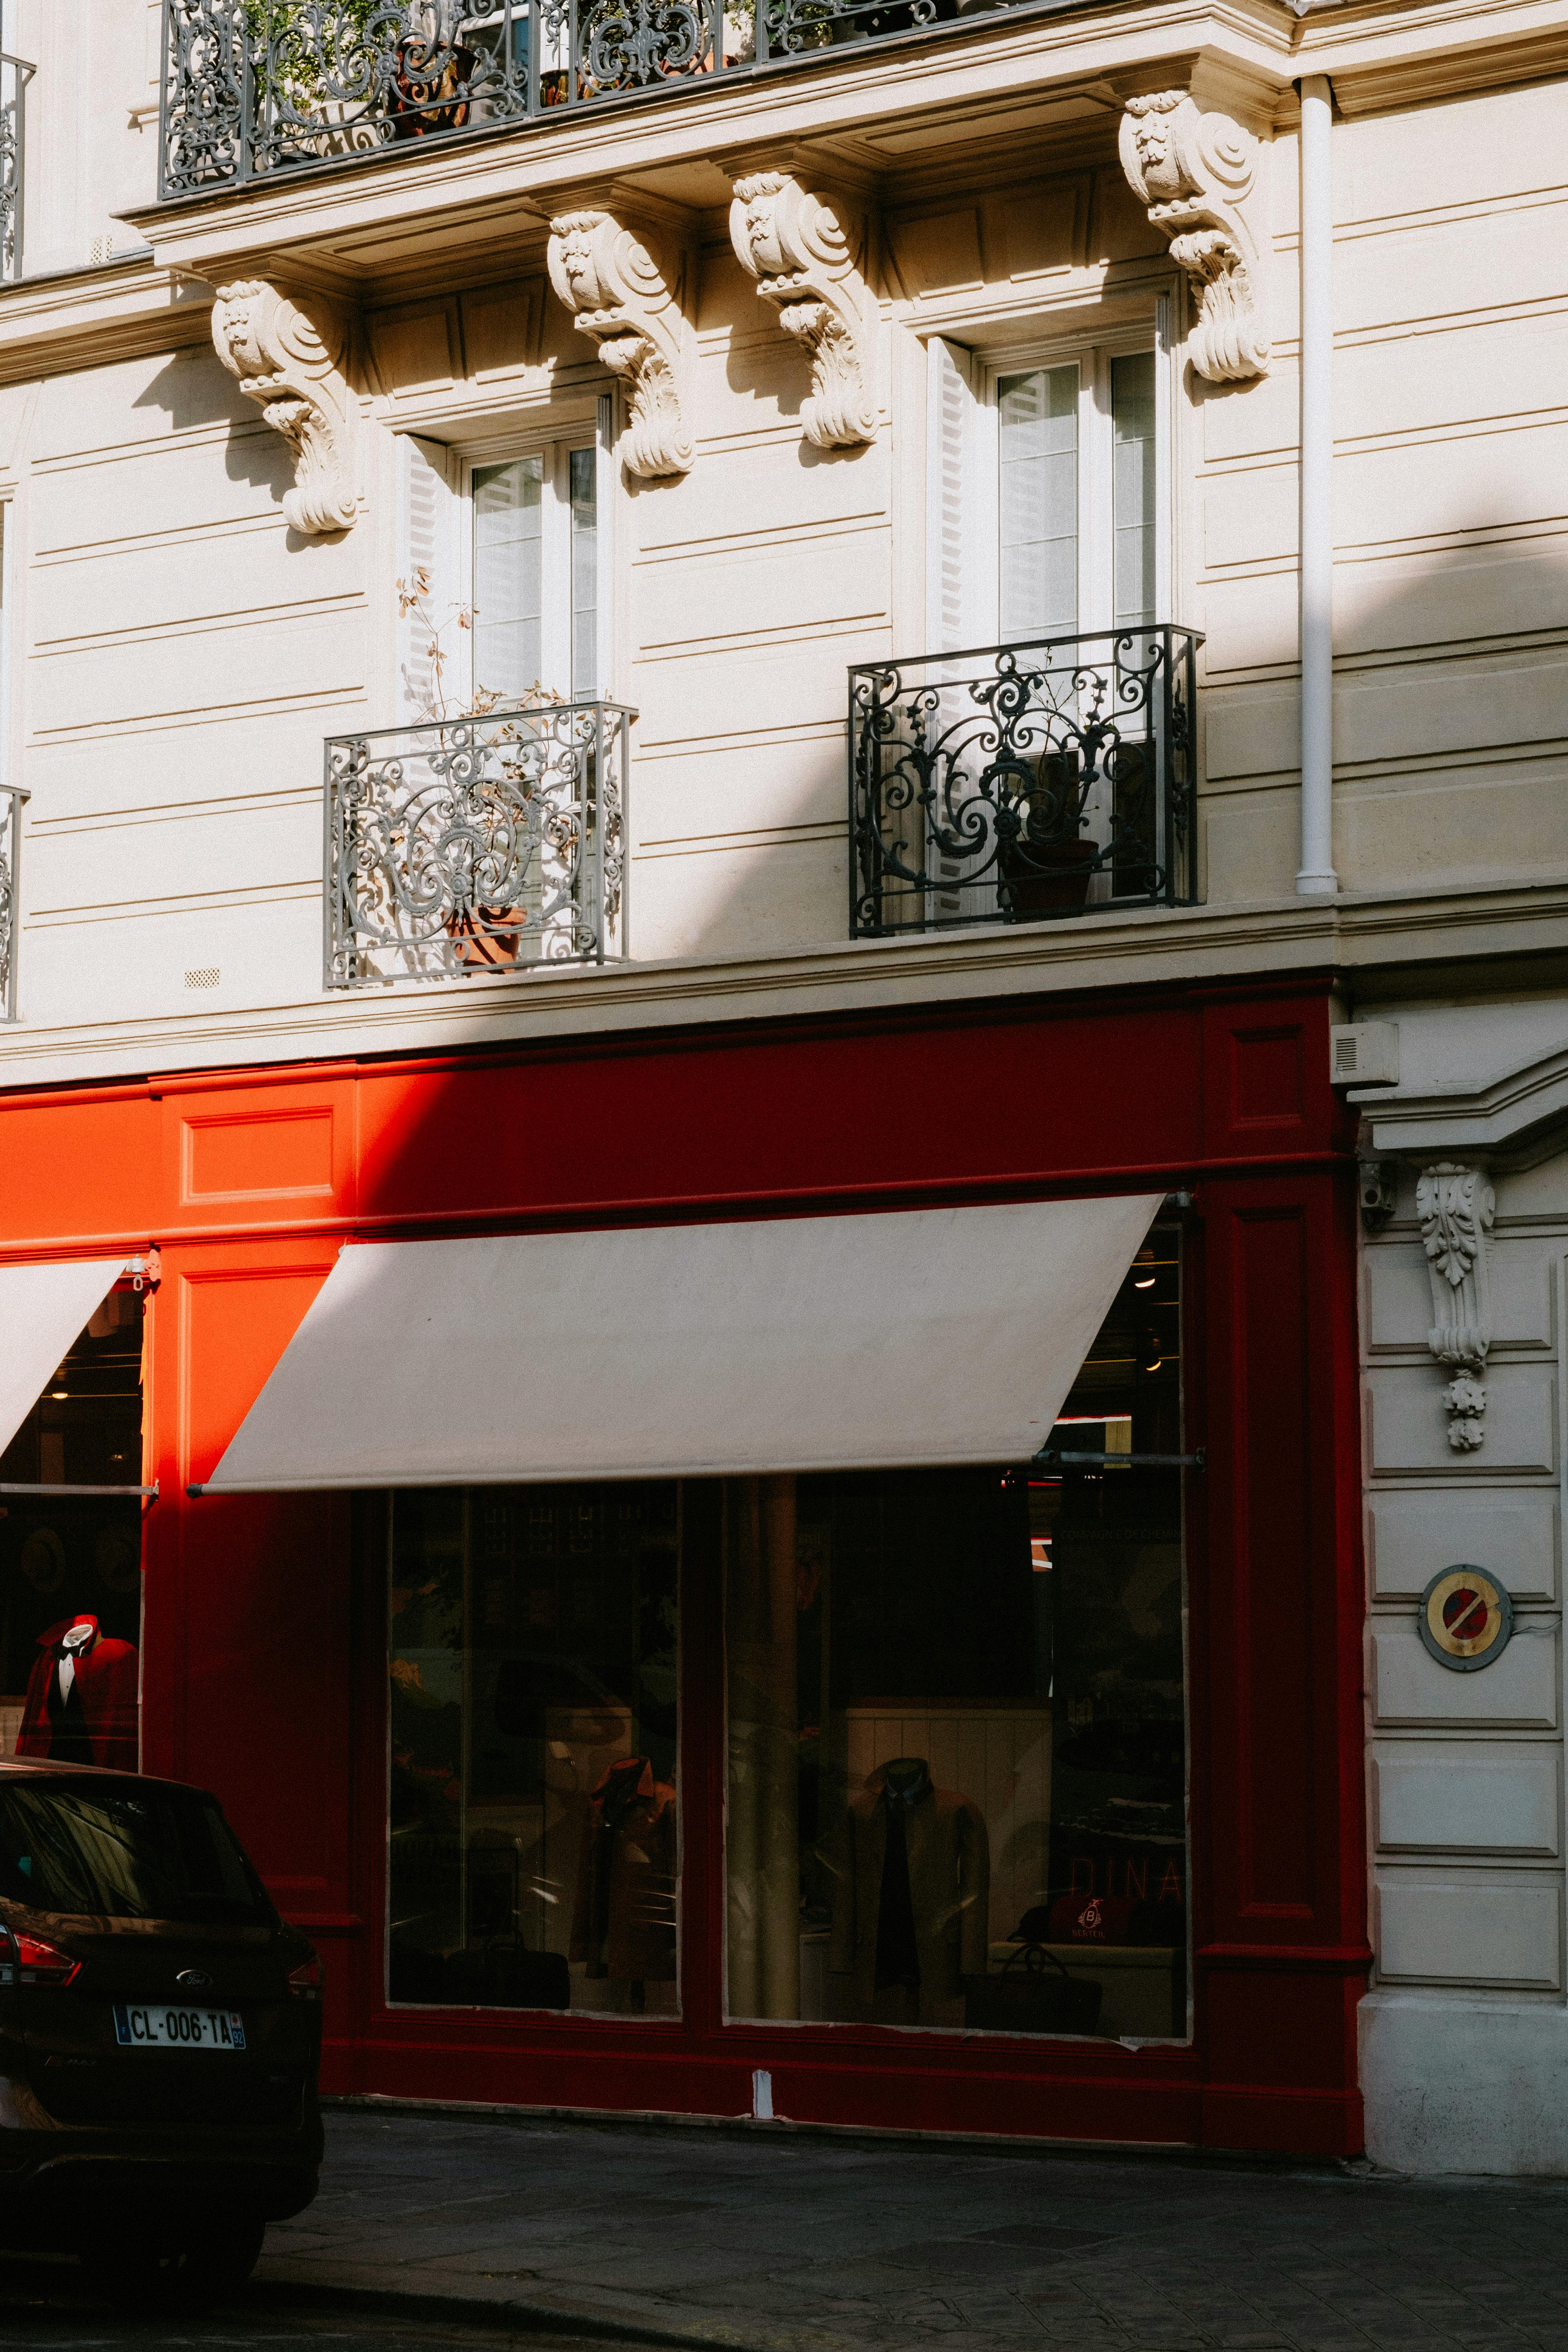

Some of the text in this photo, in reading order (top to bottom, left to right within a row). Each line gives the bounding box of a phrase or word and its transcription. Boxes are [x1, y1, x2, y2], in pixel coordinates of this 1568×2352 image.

[1071, 1857, 1183, 1904] DINA
[1087, 1911, 1095, 1921] B
[1072, 1928, 1105, 1938] BERTEIL
[131, 2010, 232, 2044] CL-006-TA
[233, 2031, 244, 2044] 92
